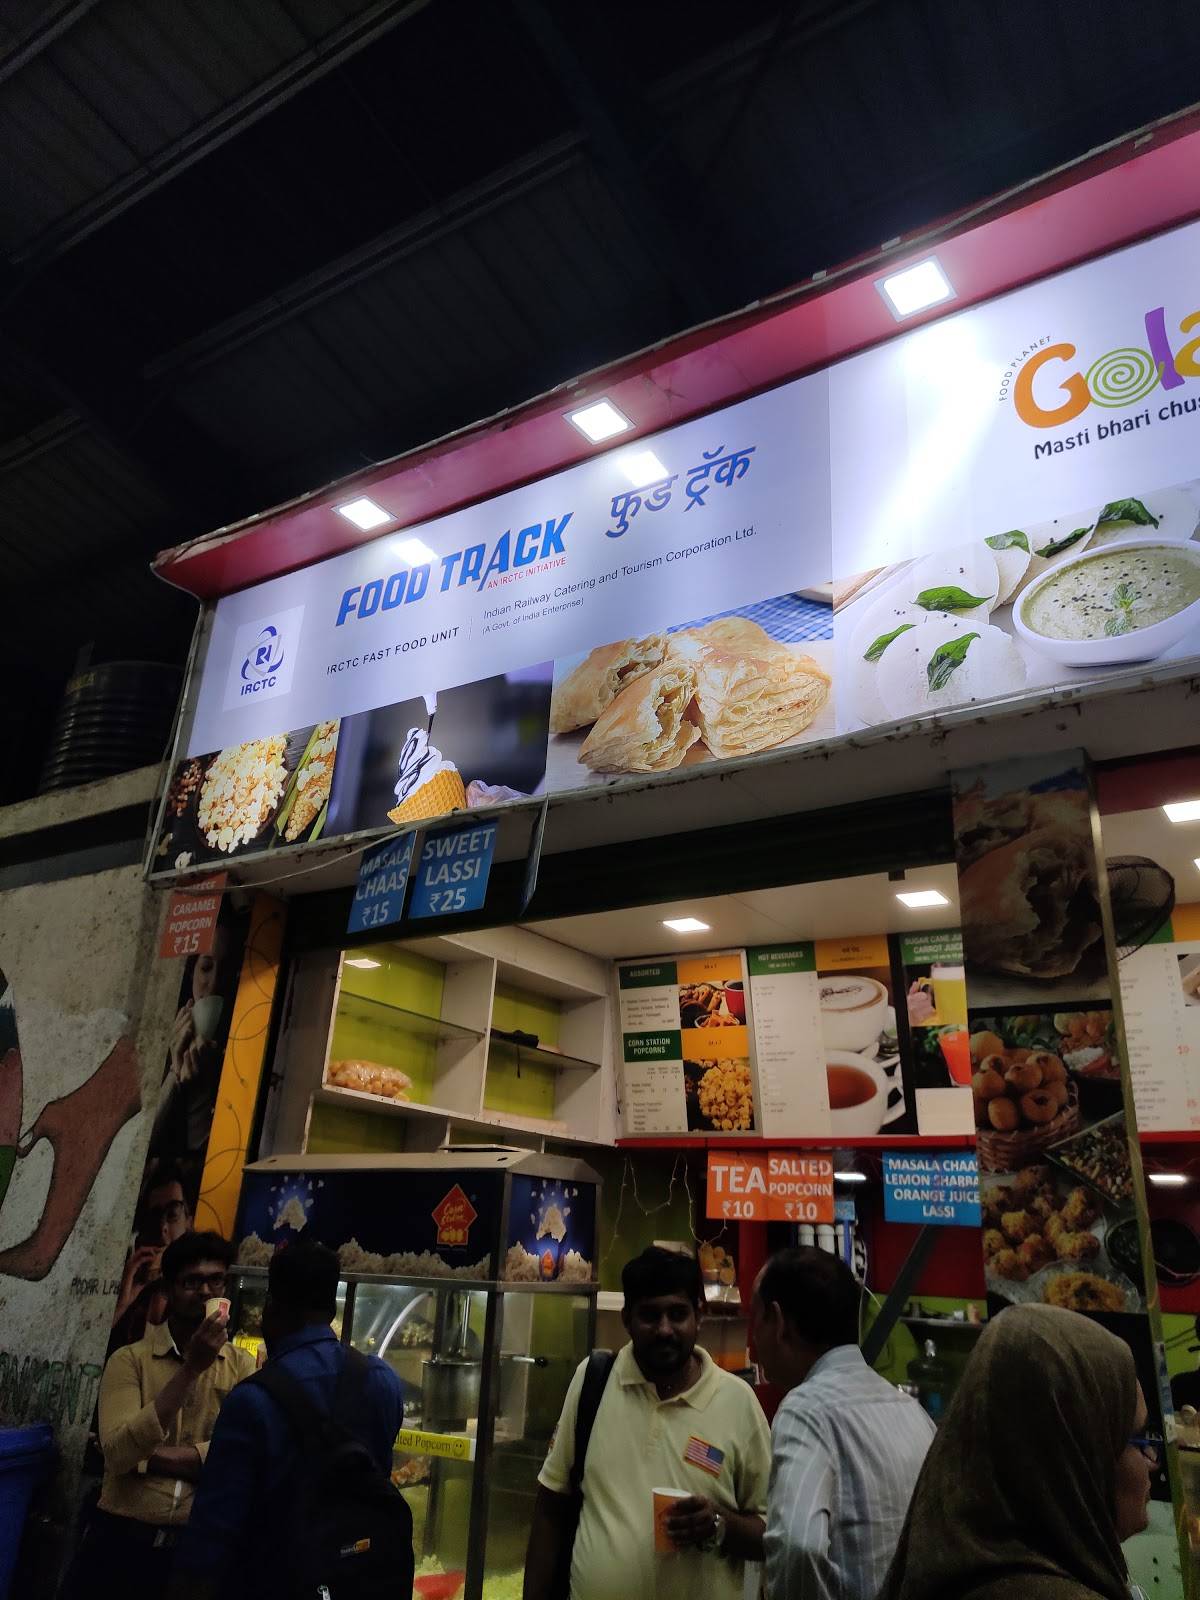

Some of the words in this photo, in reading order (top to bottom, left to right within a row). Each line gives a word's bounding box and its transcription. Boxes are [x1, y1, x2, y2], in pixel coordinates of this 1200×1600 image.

[1034, 428, 1090, 460] Masti
[1097, 409, 1151, 440] bhari
[605, 474, 679, 539] फुड
[335, 562, 431, 627] FOOD
[440, 512, 574, 592] TRACK
[483, 605, 511, 620] Indian
[514, 592, 552, 610] Railway
[553, 578, 597, 599] Catering
[598, 569, 618, 584] and
[621, 556, 662, 577] Tourism
[665, 534, 732, 562] Corporation
[735, 525, 757, 541] Ltd.
[487, 577, 501, 589] AN
[500, 570, 525, 585] IRCTC
[525, 556, 567, 577] INITIATIVE
[513, 616, 522, 625] of
[522, 611, 540, 621] India
[542, 597, 585, 616] Enterprise)
[326, 657, 360, 676] IRCTC
[362, 647, 392, 665] FAST
[394, 637, 428, 655] FOOD
[431, 626, 460, 644] UNIT
[240, 676, 277, 696] IRCTC
[422, 828, 496, 861] SWEET
[360, 845, 411, 877] MASALA
[425, 857, 481, 887] LASSI
[355, 867, 407, 901] CHAAS
[173, 898, 217, 917] CARAMEL
[429, 887, 467, 913] ₹25
[361, 901, 390, 927] ₹15
[169, 917, 213, 934] POPCORN
[173, 933, 200, 954] ₹15
[628, 1038, 645, 1047] CORN
[645, 1037, 671, 1046] STATION
[633, 1046, 666, 1055] POPCORNS
[769, 1158, 831, 1177] SALTED
[888, 1158, 940, 1171] MASALA
[943, 1159, 978, 1172] CHAA
[711, 1165, 768, 1193] TEA
[769, 1182, 832, 1197] POPCORN
[885, 1173, 930, 1186] LEMON
[894, 1188, 945, 1202] ORANGE
[949, 1191, 980, 1203] JUICE
[722, 1200, 754, 1217] ₹10
[784, 1202, 818, 1220] ₹10
[923, 1205, 955, 1218] LASSI
[415, 1435, 452, 1452] Popcorn
